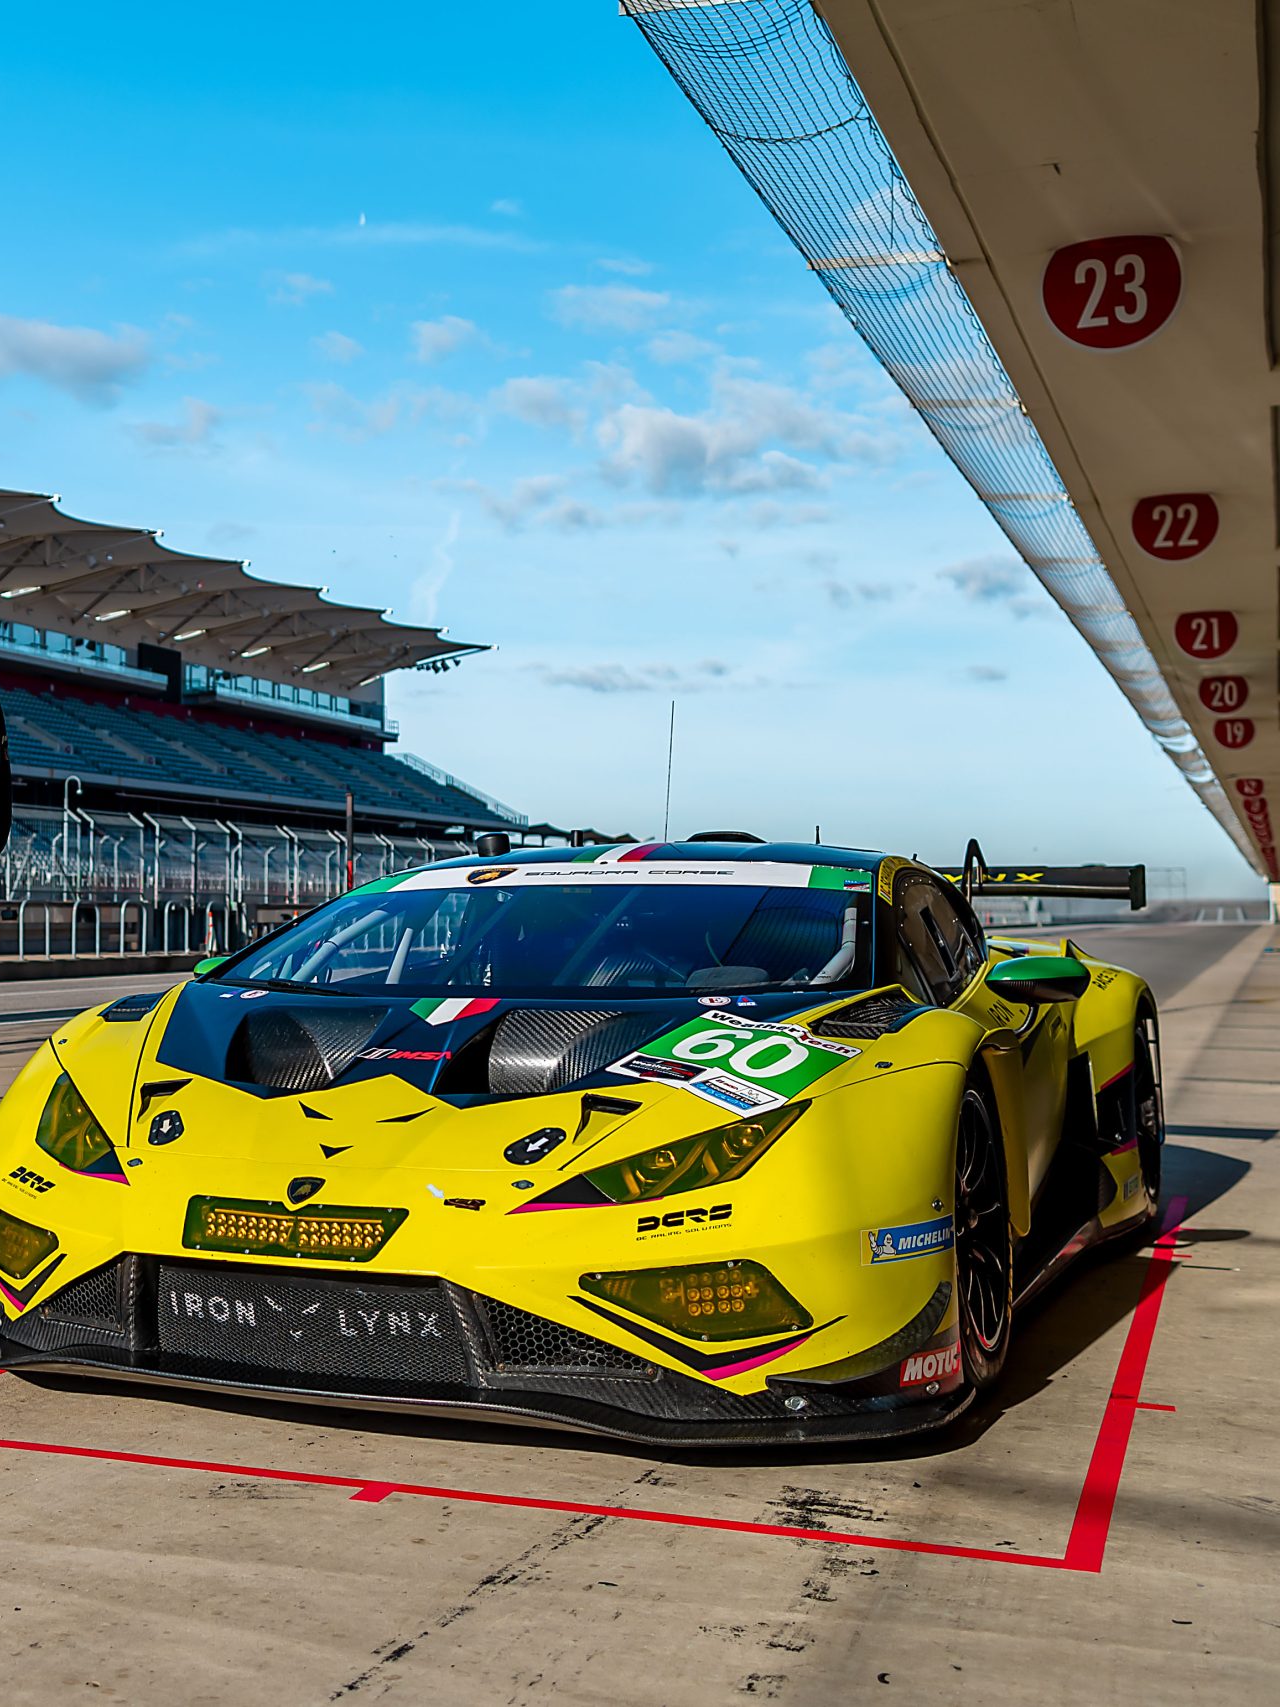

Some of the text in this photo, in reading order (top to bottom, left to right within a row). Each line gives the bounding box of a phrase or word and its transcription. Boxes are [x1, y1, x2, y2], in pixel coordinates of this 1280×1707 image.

[1074, 254, 1148, 329] 23
[1151, 503, 1199, 548] 22
[1190, 617, 1220, 650] 21
[1210, 681, 1238, 707] 20
[1225, 721, 1245, 744] 19
[987, 1000, 1015, 1028] IRON
[387, 1051, 452, 1061] IMSA
[672, 1029, 809, 1078] 60
[898, 1227, 951, 1251] MICHELIN
[171, 1290, 443, 1338] IRON LYNX
